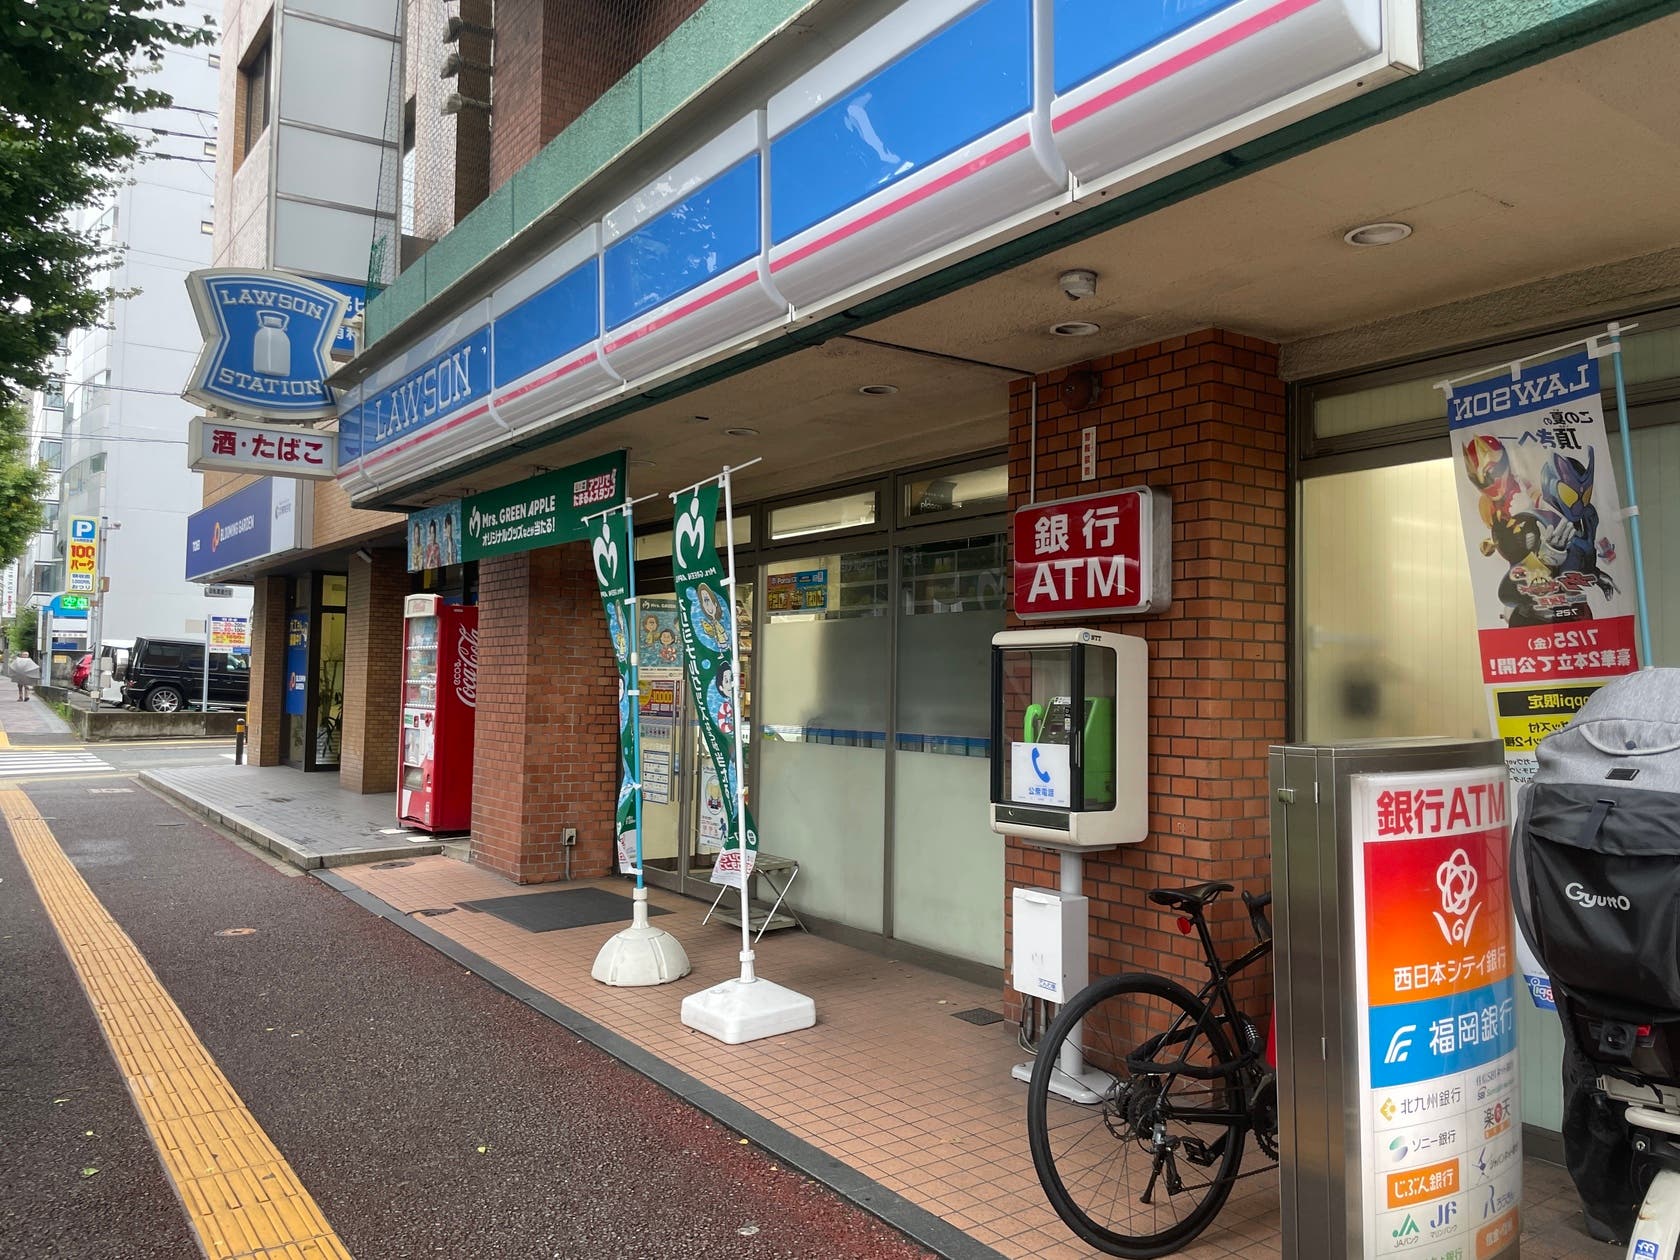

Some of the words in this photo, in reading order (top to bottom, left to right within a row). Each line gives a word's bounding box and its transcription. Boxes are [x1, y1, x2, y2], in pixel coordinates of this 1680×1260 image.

[220, 289, 326, 321] LAWSON
[218, 366, 324, 397] STATION
[374, 345, 472, 443] LAWSON
[211, 428, 324, 465] 酒・たばこ
[239, 514, 255, 534] GARDEN
[482, 513, 498, 528] Mrs.
[499, 502, 527, 524] GREEN
[527, 494, 556, 517] APPLE
[76, 521, 93, 537] P
[1034, 505, 1120, 556] 銀行
[71, 545, 96, 558] 100
[71, 559, 95, 571] パーク
[1027, 554, 1126, 603] ATM
[456, 623, 479, 707] Coca-Cola
[1028, 787, 1055, 797] 公衆電話
[1377, 782, 1505, 836] 銀行ATM
[1394, 946, 1506, 992] 西日本シティ銀行
[1429, 998, 1513, 1055] 福岡銀行
[1400, 1087, 1461, 1114] 北九州銀行
[1412, 1129, 1456, 1152] ソニー銀行
[1393, 1168, 1454, 1200] じぶん銀行
